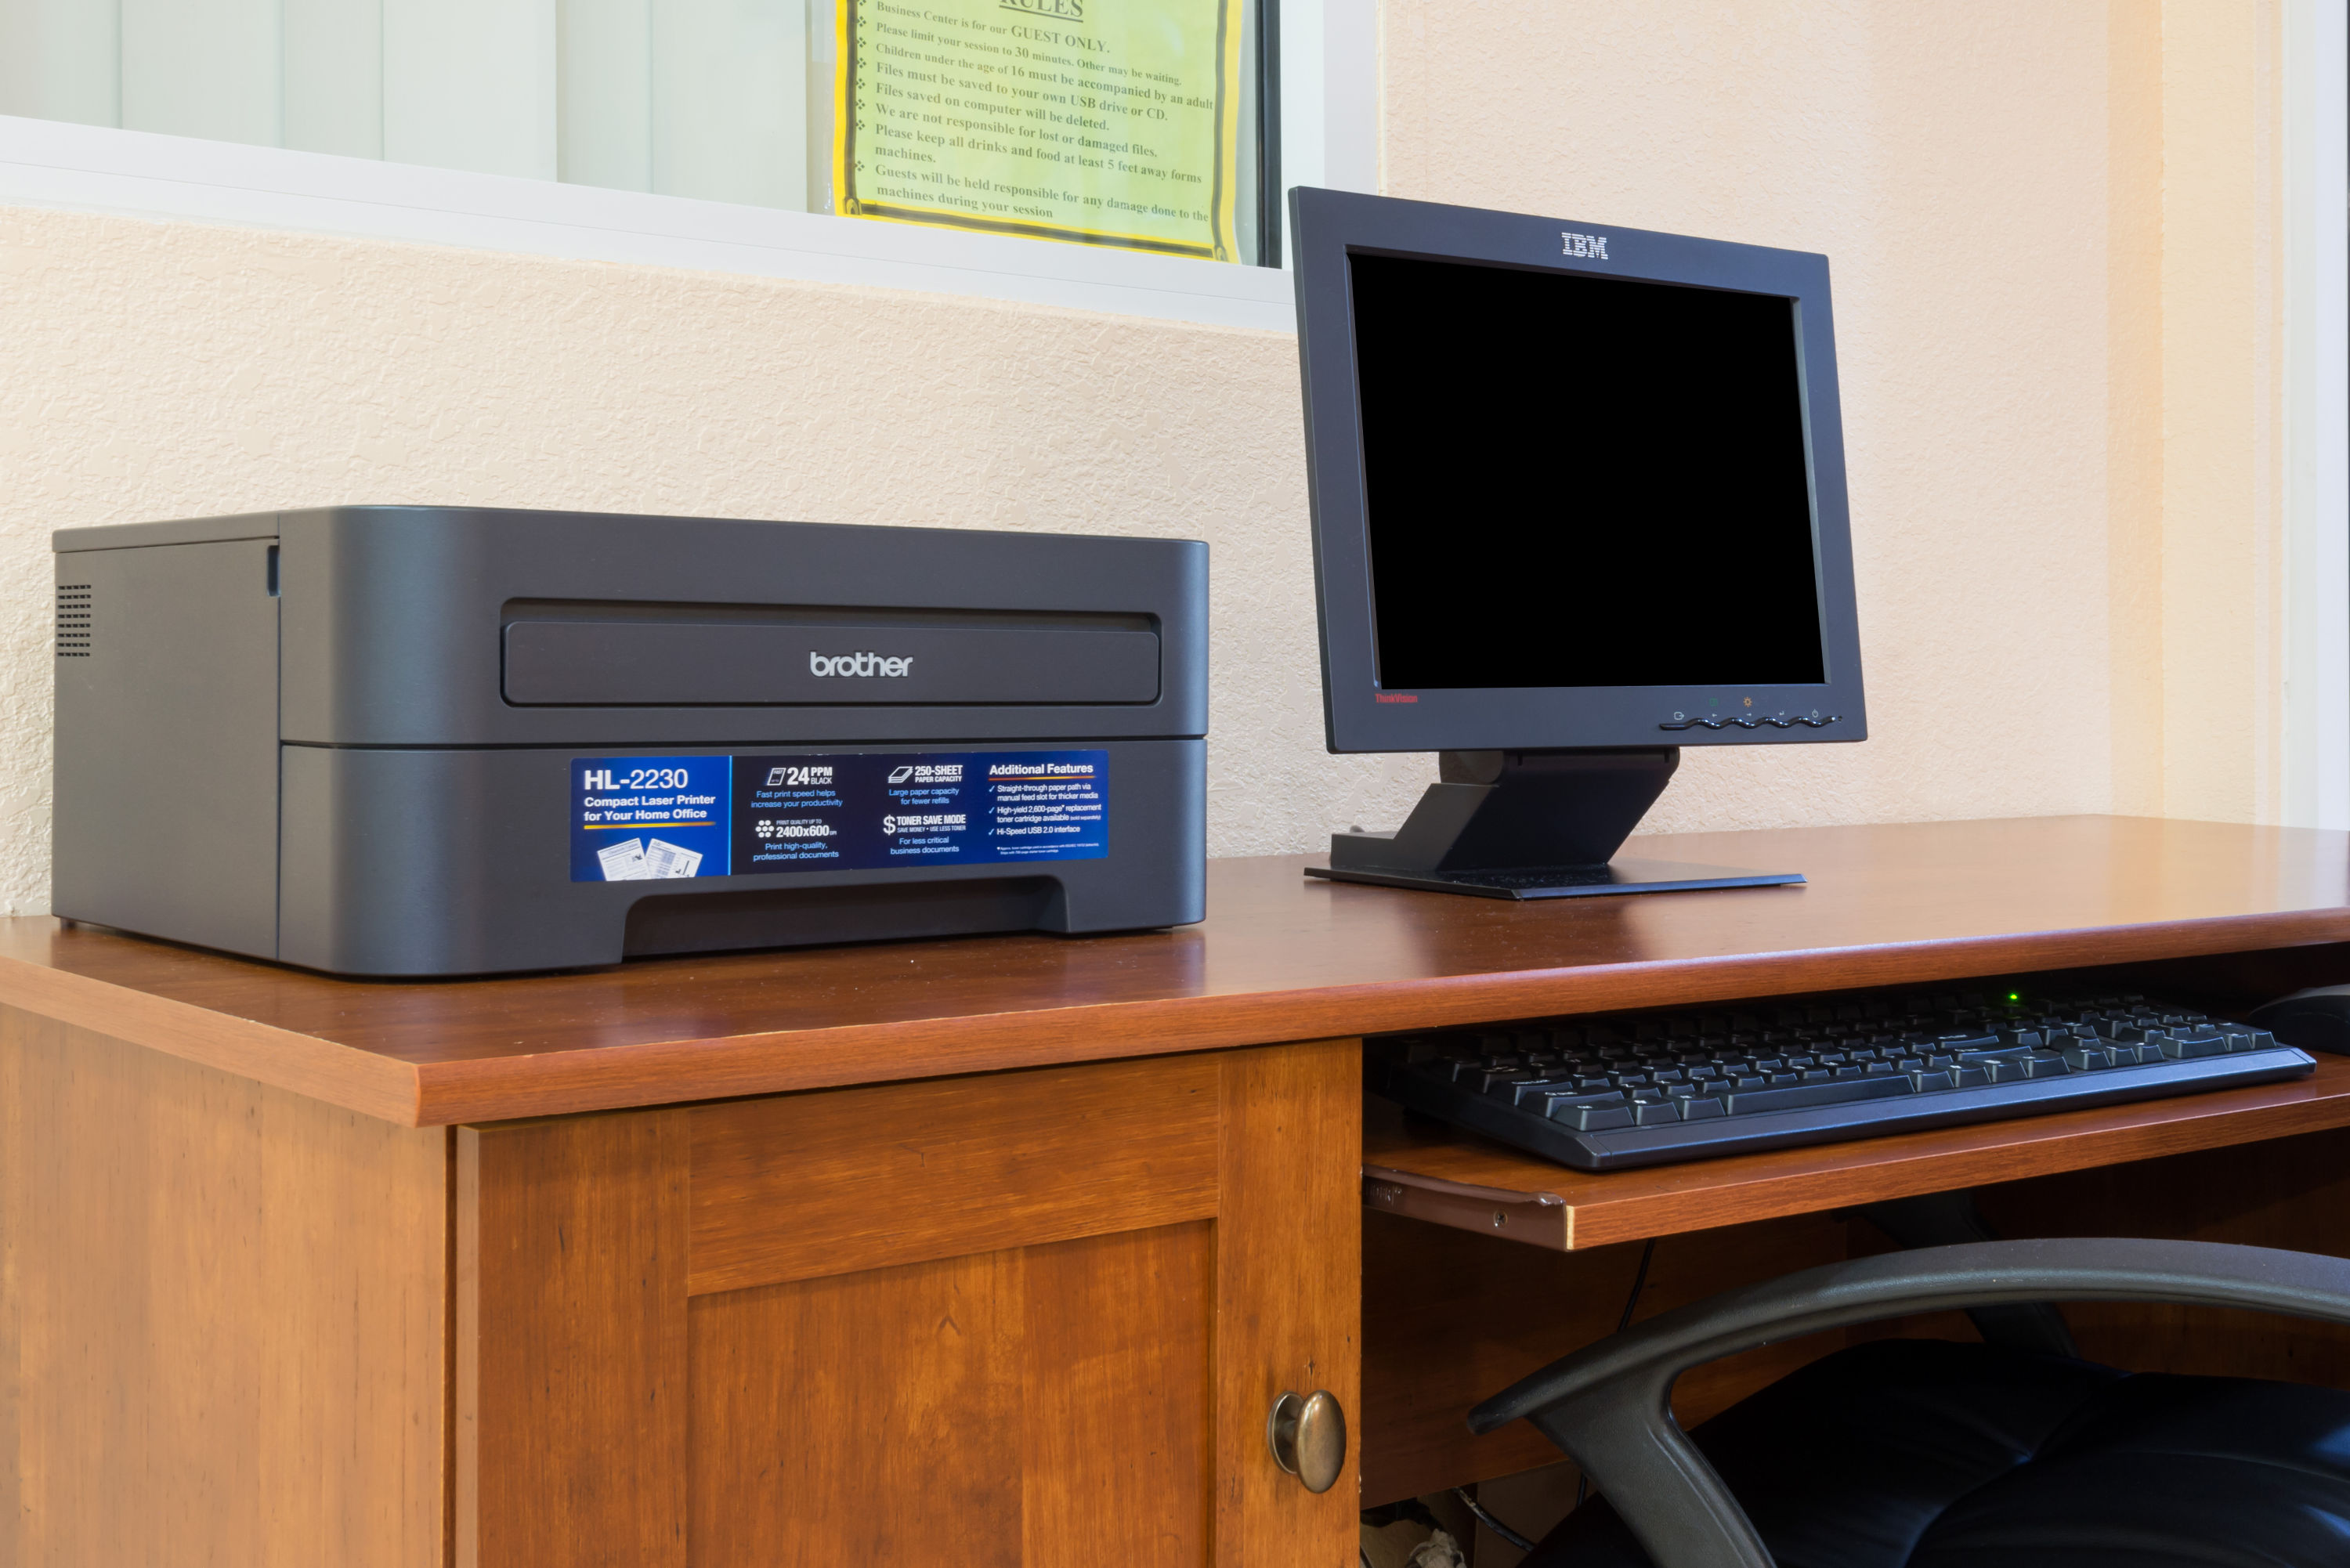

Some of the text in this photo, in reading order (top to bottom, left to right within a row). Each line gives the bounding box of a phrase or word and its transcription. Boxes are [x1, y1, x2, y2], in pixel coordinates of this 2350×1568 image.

[1001, 0, 1083, 17] LES
[877, 2, 1110, 53] Business Center is for our GUEST ONLY.
[877, 22, 1181, 88] Please limit your session to 30 minutes. Other may be waiting.
[877, 43, 1213, 110] Children under the age of 16 must be accompanied by an adult
[877, 62, 1168, 121] Files must be saved to your own USB drive or CD.
[877, 82, 1110, 131] Files saved on computer will be deleted.
[876, 103, 1158, 157] We are not responsible for lost or damaged files.
[875, 146, 936, 163] machines.
[876, 124, 1202, 183] Please keep all drinks and food at least 5 feet away forms
[876, 164, 1209, 222] Guests will be held responsible for any damage done to the
[877, 186, 1053, 218] machines during your session
[1561, 232, 1608, 259] IBM
[810, 651, 913, 677] brother
[811, 767, 833, 776] PPM
[915, 764, 963, 776] 250-SHEET
[989, 763, 1094, 775] Additional Features
[584, 768, 689, 789] HL-2230
[786, 767, 809, 785] 24
[774, 790, 790, 799] print
[792, 789, 815, 798] speed
[888, 789, 909, 797] Large
[931, 787, 960, 796] capacity
[997, 784, 1047, 793] Straight-through
[584, 795, 716, 808] Compact Laser Printer
[783, 800, 800, 809] your
[801, 799, 843, 807] productivity
[584, 808, 707, 821] for Your Home Office
[996, 806, 1028, 815] High-yield
[1065, 804, 1101, 812] replacement
[896, 814, 966, 826] TONER SAVE MODE
[1014, 815, 1042, 823] cartridge
[776, 825, 830, 837] 2400x600
[996, 827, 1026, 836] Hi-Speed
[927, 836, 949, 844] critical
[753, 851, 840, 862] professional documents
[890, 847, 920, 855] business
